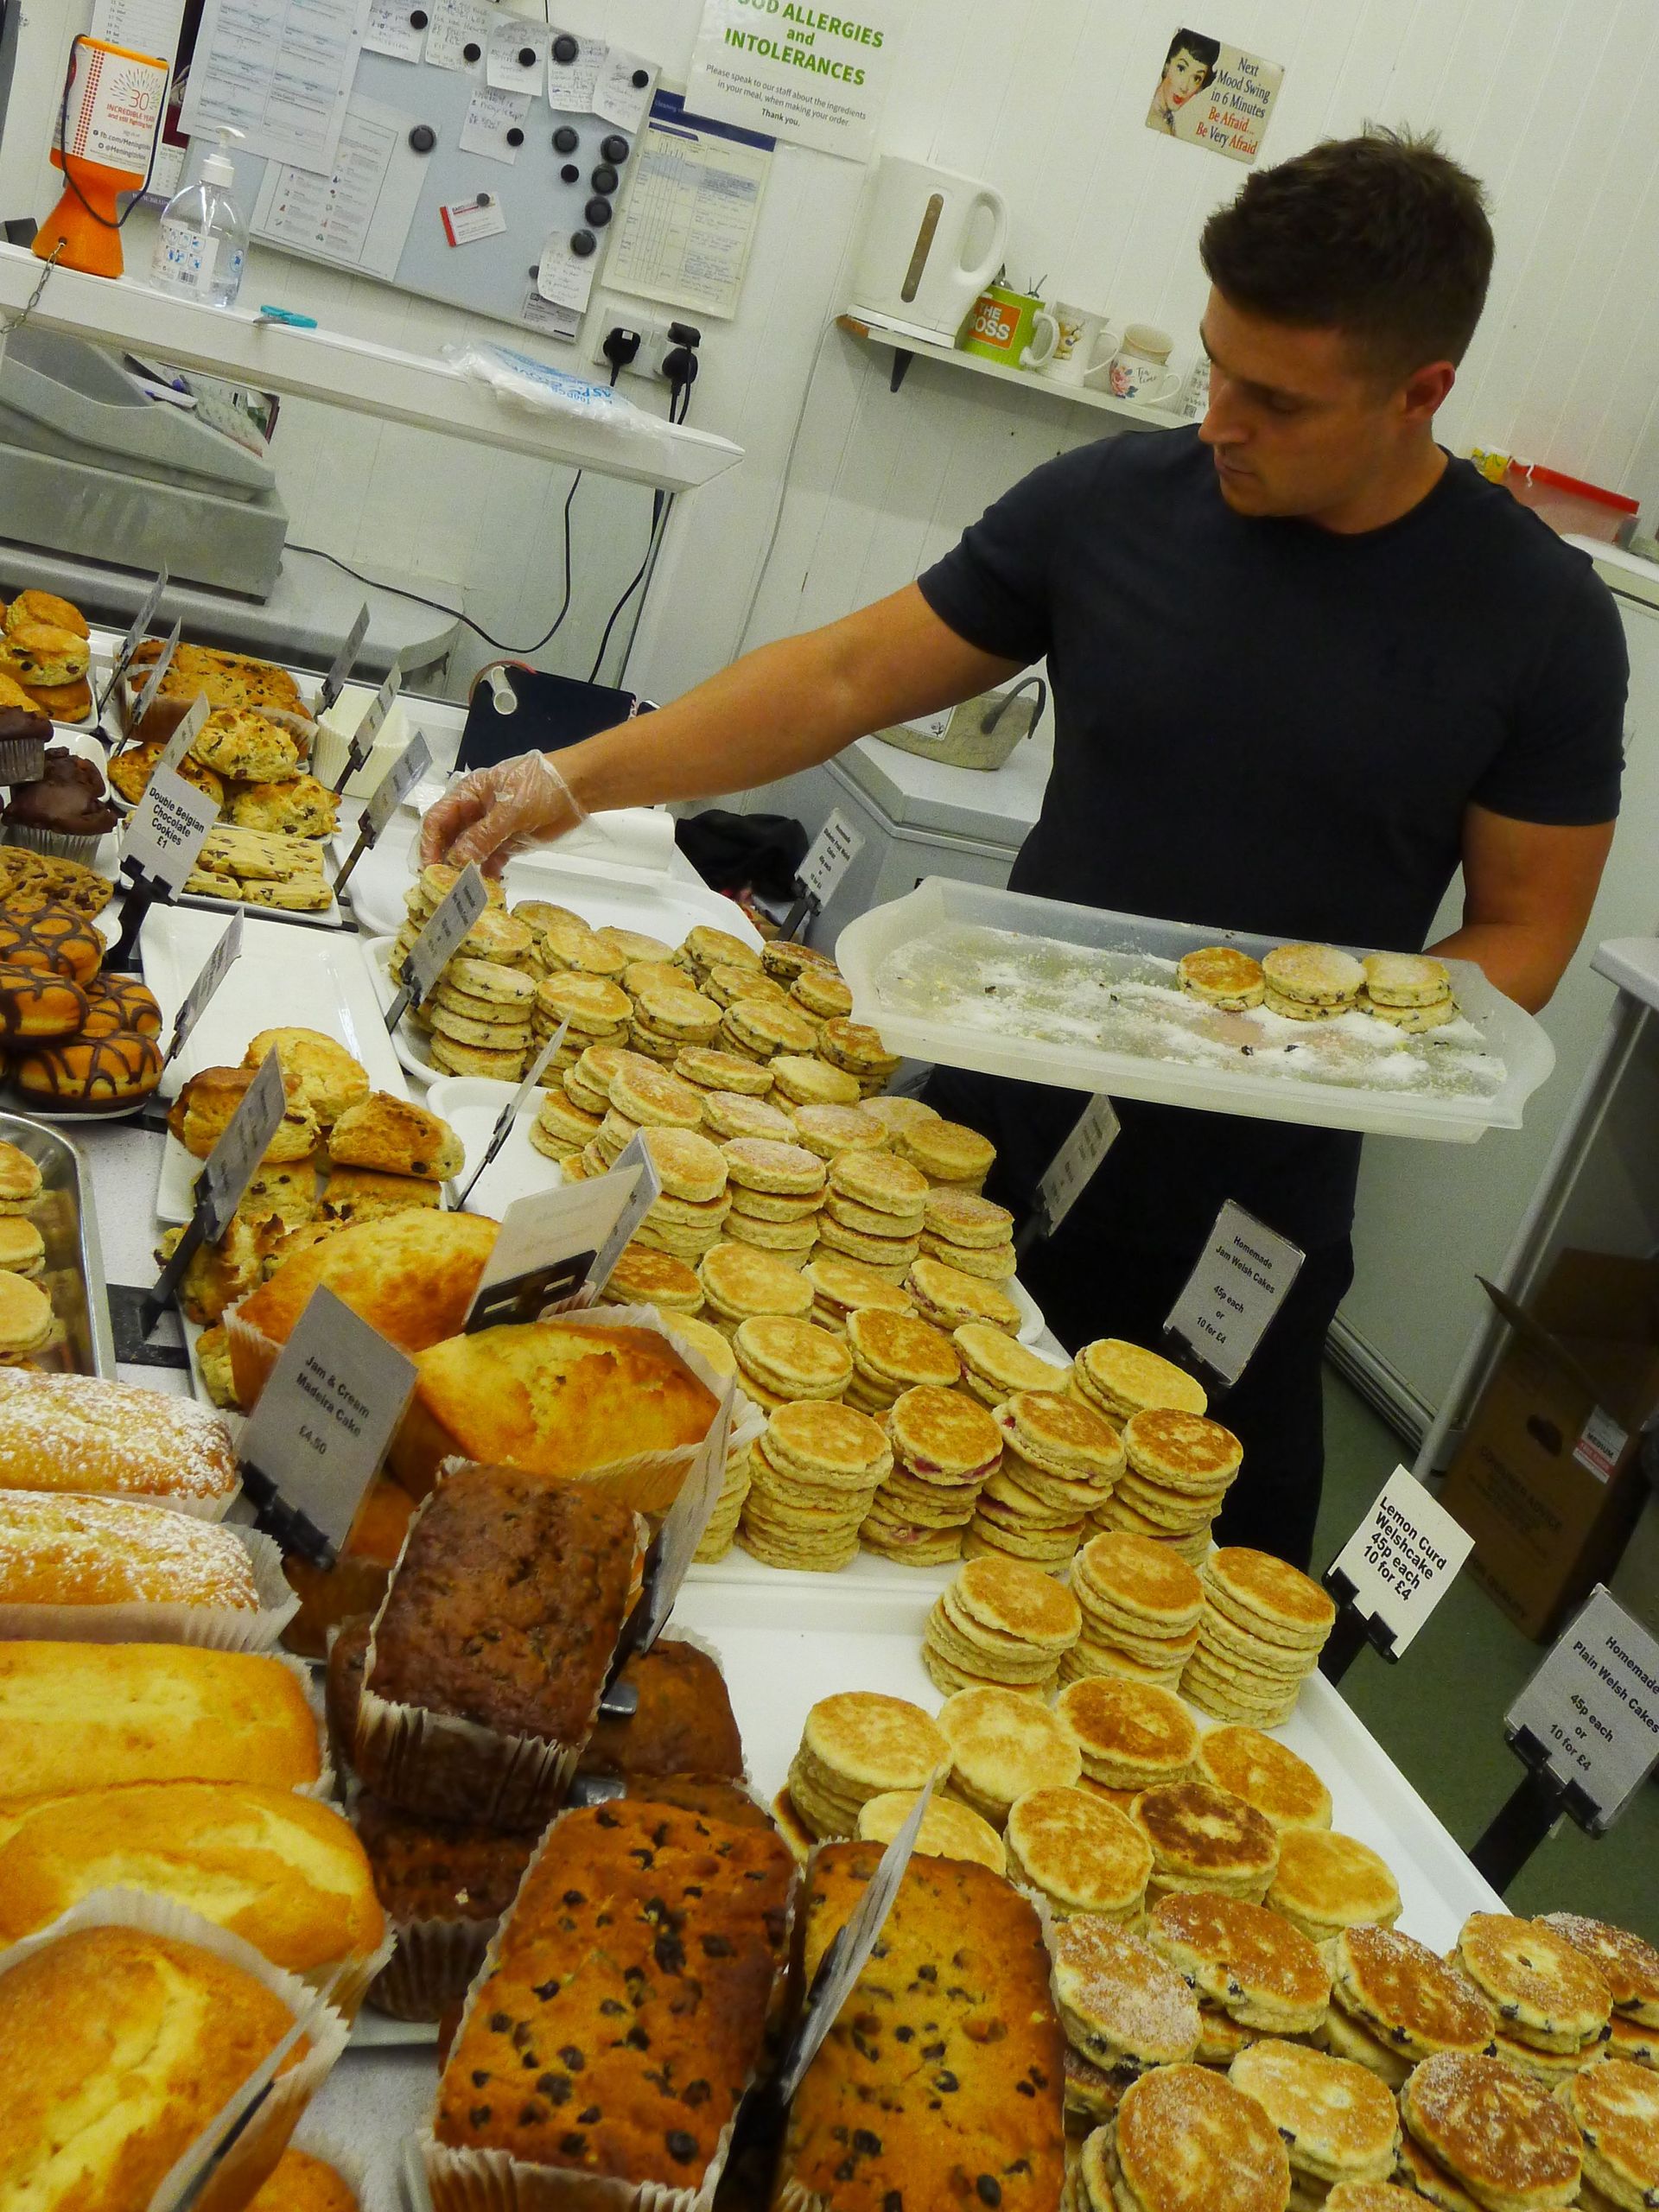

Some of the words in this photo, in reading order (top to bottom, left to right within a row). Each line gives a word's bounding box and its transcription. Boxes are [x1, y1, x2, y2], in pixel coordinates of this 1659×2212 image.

[782, 3, 885, 48] ALLERGIES
[786, 28, 816, 47] and
[724, 28, 866, 86] INTOLERANCES
[1237, 57, 1260, 76] Next
[130, 89, 149, 111] 30
[707, 64, 730, 79] Please
[731, 71, 753, 86] speak
[753, 78, 761, 87] to
[762, 81, 776, 92] our
[776, 83, 791, 99] staff
[791, 89, 813, 104] about
[814, 95, 826, 108] the
[826, 100, 866, 120] ingredients
[1217, 69, 1244, 91] Mood
[1244, 79, 1270, 104] Swing
[107, 104, 142, 119] INCREDIBLE
[717, 80, 724, 90] in
[726, 84, 743, 97] your
[743, 88, 764, 103] meal,
[764, 94, 785, 109] when
[785, 99, 810, 118] making
[810, 108, 829, 123] your
[829, 112, 850, 128] order.
[762, 107, 785, 123] Thank
[785, 114, 800, 128] you.
[1208, 105, 1220, 122] Be
[1211, 90, 1220, 102] in
[1222, 92, 1230, 105] 6
[1229, 94, 1266, 118] Minutes
[1196, 121, 1208, 137] Be
[1210, 125, 1229, 149] Very
[1229, 135, 1258, 156] Afraid
[973, 316, 1010, 340] OSS
[980, 304, 1002, 321] HE
[149, 787, 175, 812] Double
[175, 806, 206, 833] Belgian
[153, 804, 191, 838] Chocolate
[151, 817, 182, 847] Cookies
[156, 836, 168, 849] £1
[1216, 1246, 1230, 1262] Jam
[1231, 1256, 1253, 1279] Welsh
[1253, 1274, 1275, 1294] Cakes
[1233, 1236, 1273, 1270] Homemade
[1213, 1284, 1227, 1300] 45p
[1227, 1296, 1244, 1313] each
[1216, 1310, 1225, 1320] or
[1197, 1316, 1206, 1328] 10
[1205, 1322, 1217, 1336] for
[1215, 1332, 1227, 1344] £4
[305, 1356, 326, 1381] Jam
[327, 1374, 337, 1389] &
[337, 1382, 371, 1419] Cream
[296, 1372, 334, 1415] Madeira
[335, 1408, 362, 1438] Cake
[299, 1426, 327, 1455] £4.50
[1586, 1431, 1614, 1459] MEDIUM
[1375, 1511, 1434, 1581] Welshcake
[1379, 1496, 1418, 1541] Lemon
[1418, 1536, 1448, 1571] Curd
[1364, 1545, 1379, 1565] 10
[1377, 1560, 1396, 1584] for
[1395, 1580, 1414, 1602] £4
[1370, 1531, 1393, 1559] 45p
[1392, 1554, 1421, 1591] each
[1605, 1636, 1659, 1695] Homemade
[1573, 1640, 1599, 1670] Plain
[1598, 1664, 1629, 1702] Welsh
[1628, 1696, 1659, 1734] Cakes
[1569, 1693, 1590, 1718] 45p
[1588, 1713, 1614, 1744] each
[1574, 1726, 1588, 1740] or
[1550, 1723, 1564, 1740] 10
[1561, 1737, 1578, 1758] for
[1576, 1754, 1592, 1771] £4
